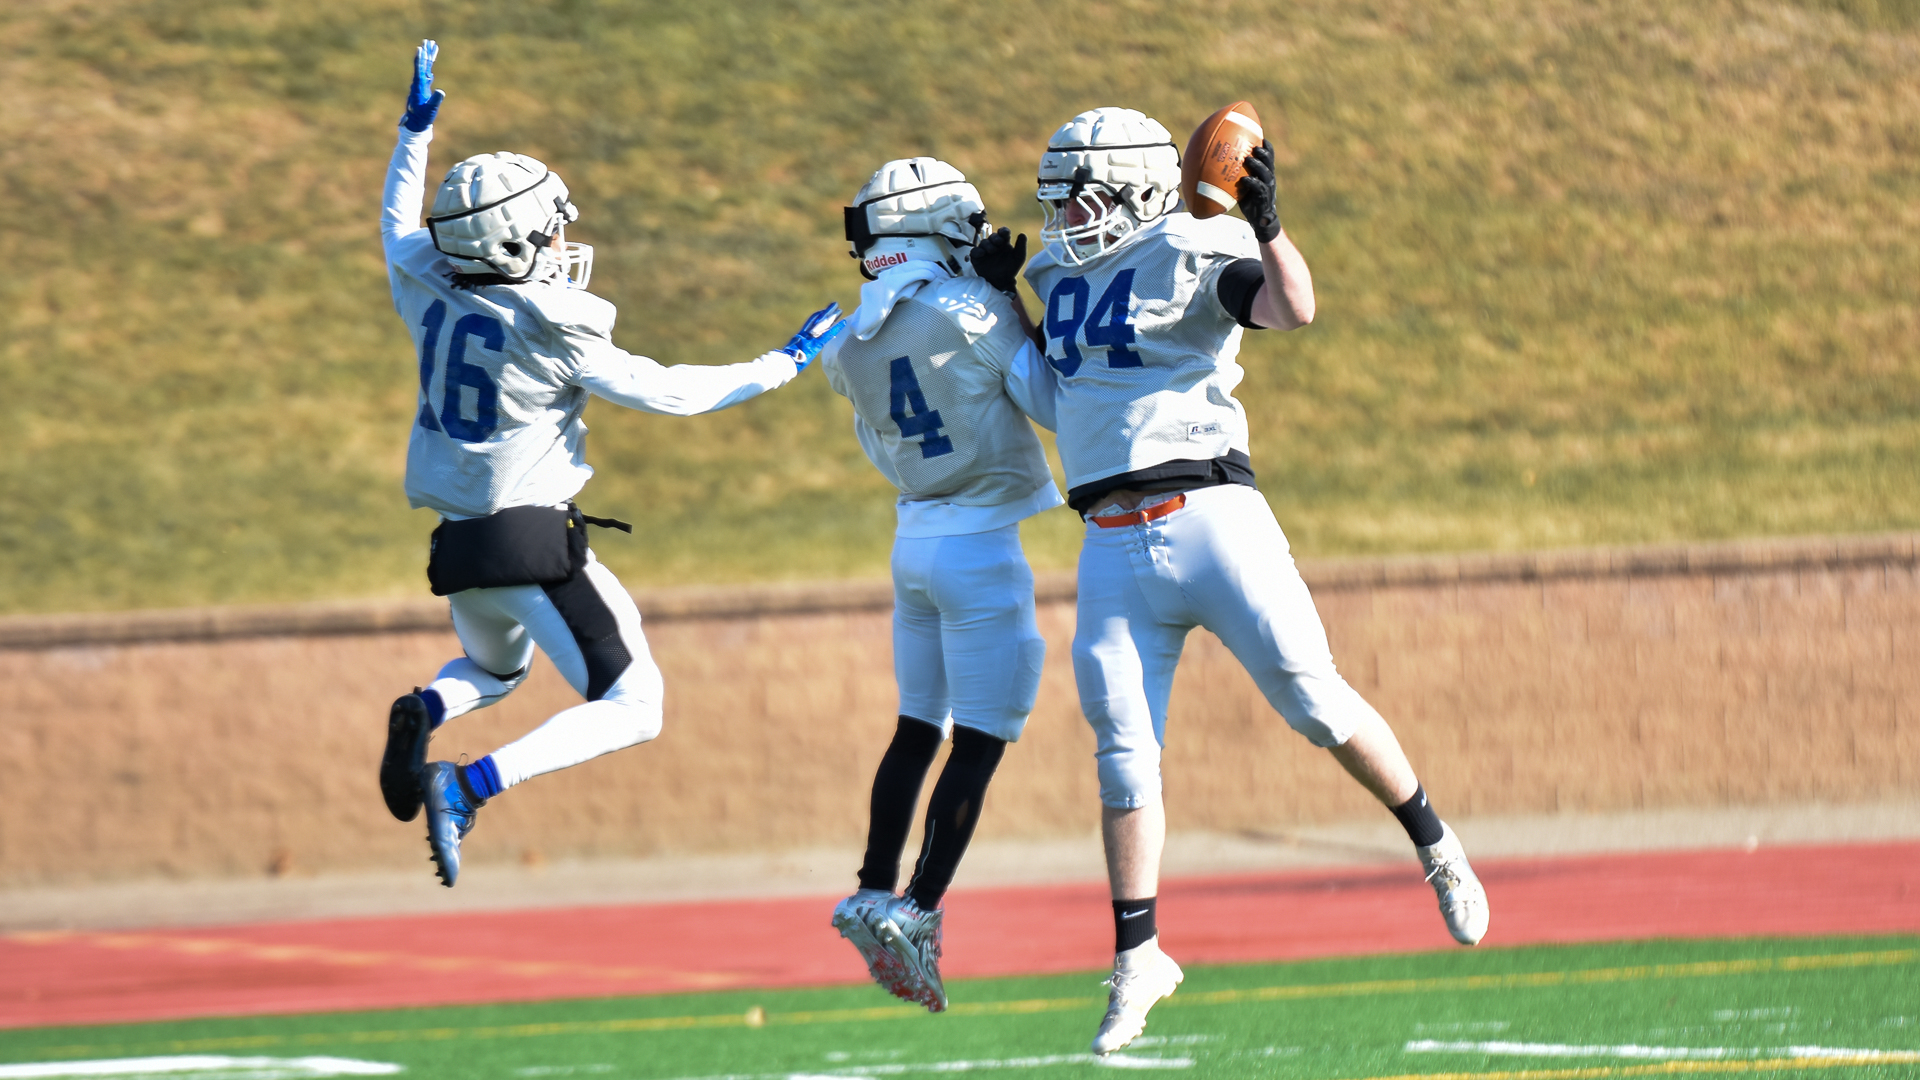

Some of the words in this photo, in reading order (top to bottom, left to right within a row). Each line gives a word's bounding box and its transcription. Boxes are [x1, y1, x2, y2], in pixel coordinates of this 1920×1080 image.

[865, 252, 908, 271] Riddell
[419, 298, 506, 443] 16
[1046, 268, 1144, 378] 94
[890, 355, 954, 459] 4
